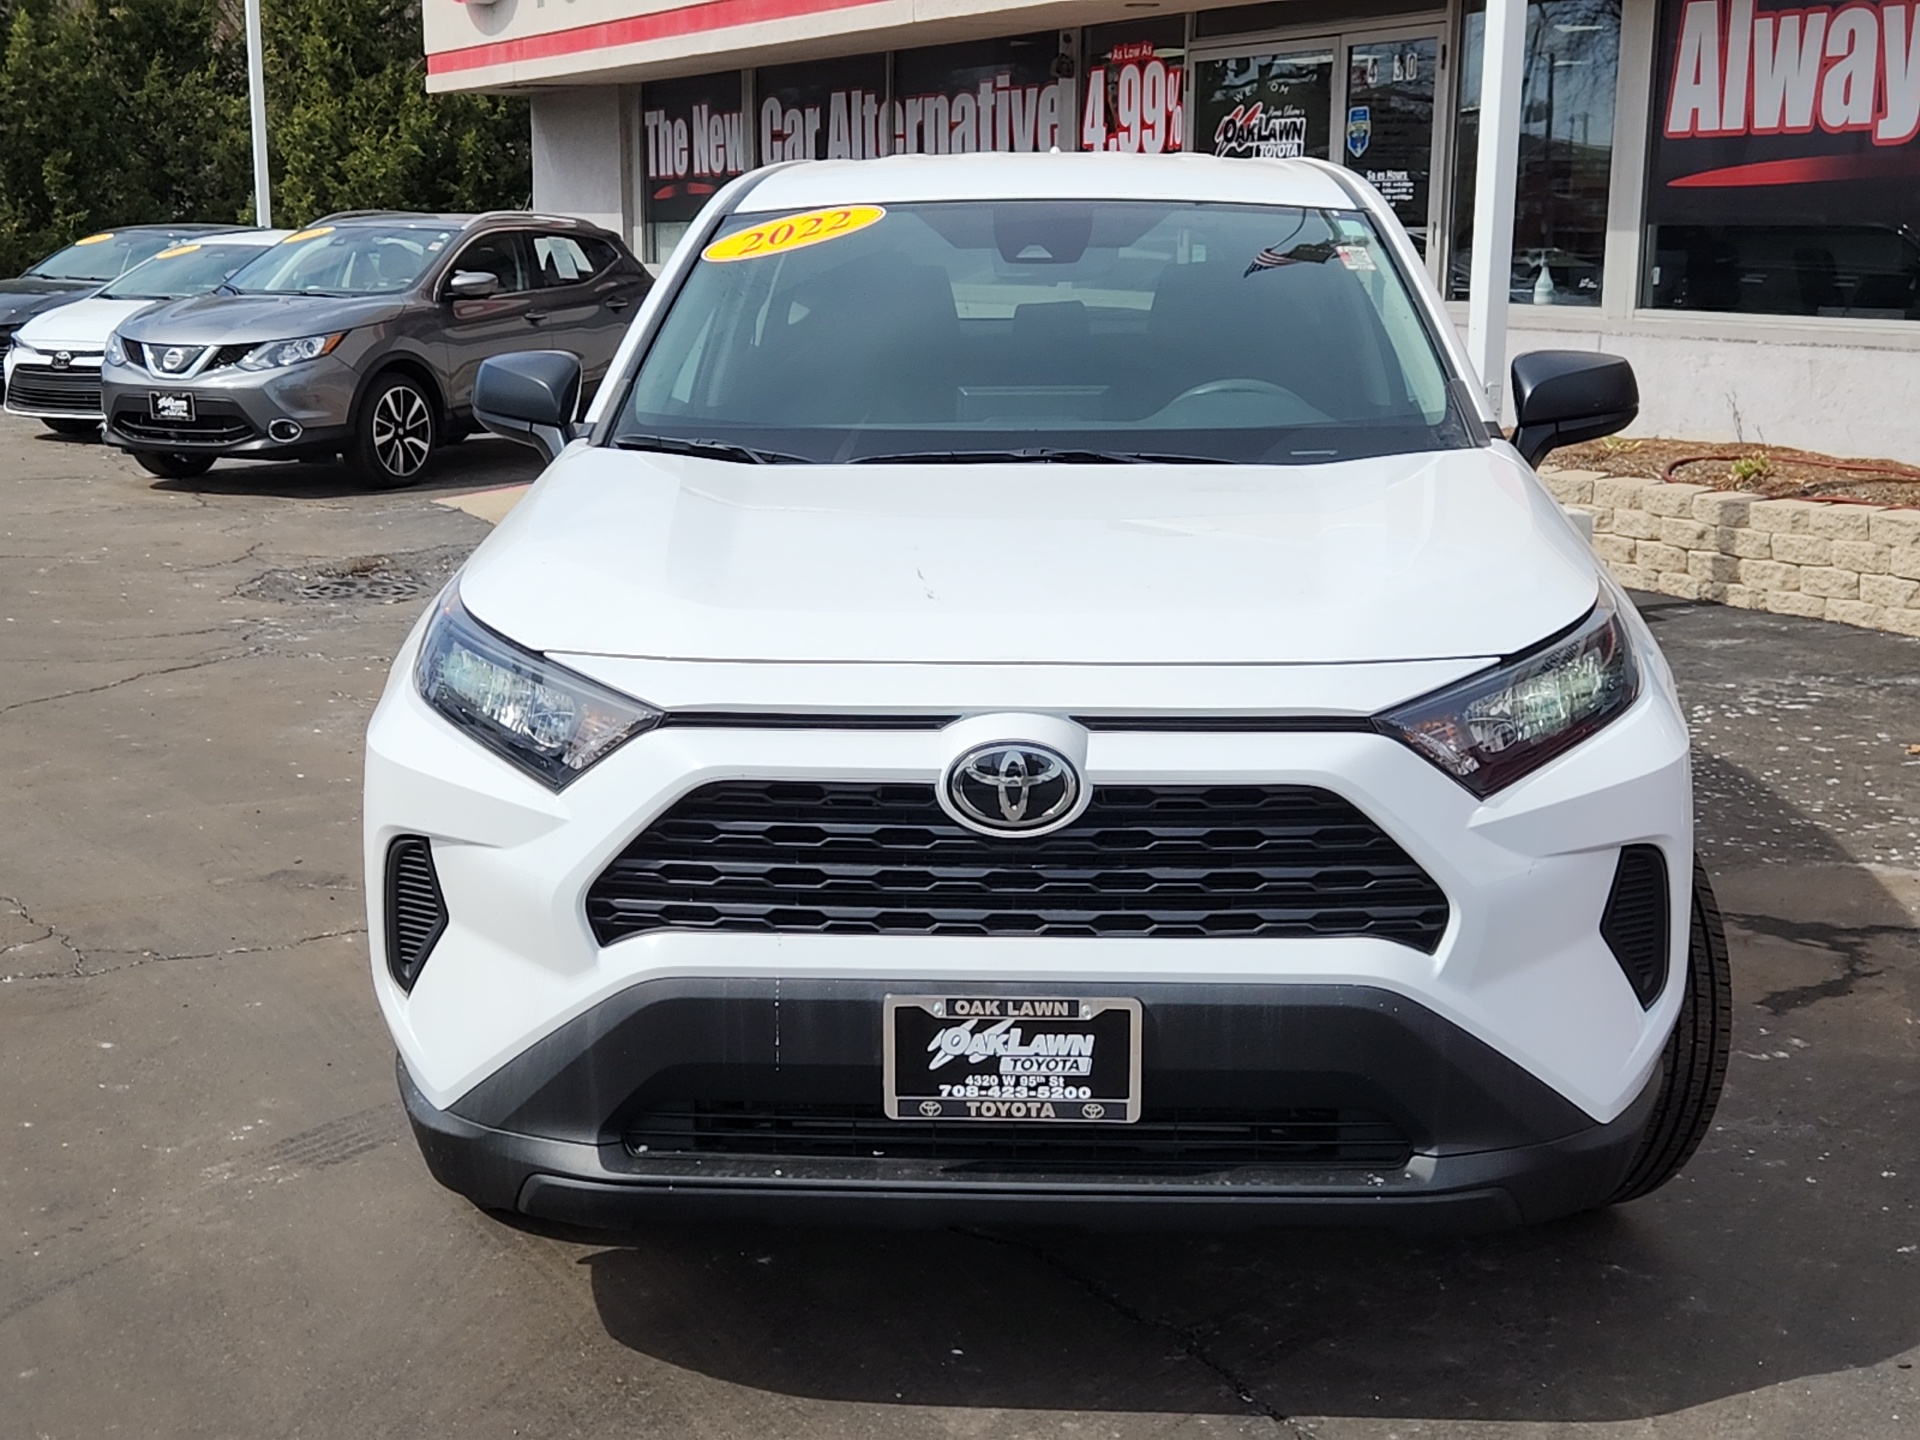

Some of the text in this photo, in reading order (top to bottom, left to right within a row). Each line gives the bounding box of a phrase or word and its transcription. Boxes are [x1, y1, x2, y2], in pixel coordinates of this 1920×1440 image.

[1083, 60, 1182, 153] 4.99%
[645, 109, 689, 180] The
[692, 104, 743, 177] New
[761, 96, 822, 166] Car
[1259, 144, 1299, 158] TOYOTA
[738, 210, 852, 256] 2022
[954, 1000, 1069, 1016] OAK LAWN
[1010, 1058, 1081, 1072] TOYOTA
[965, 1075, 1065, 1088] 4320 W 95th St
[938, 1084, 1092, 1100] 708-423-5200
[966, 1101, 1056, 1118] TOYOTA
